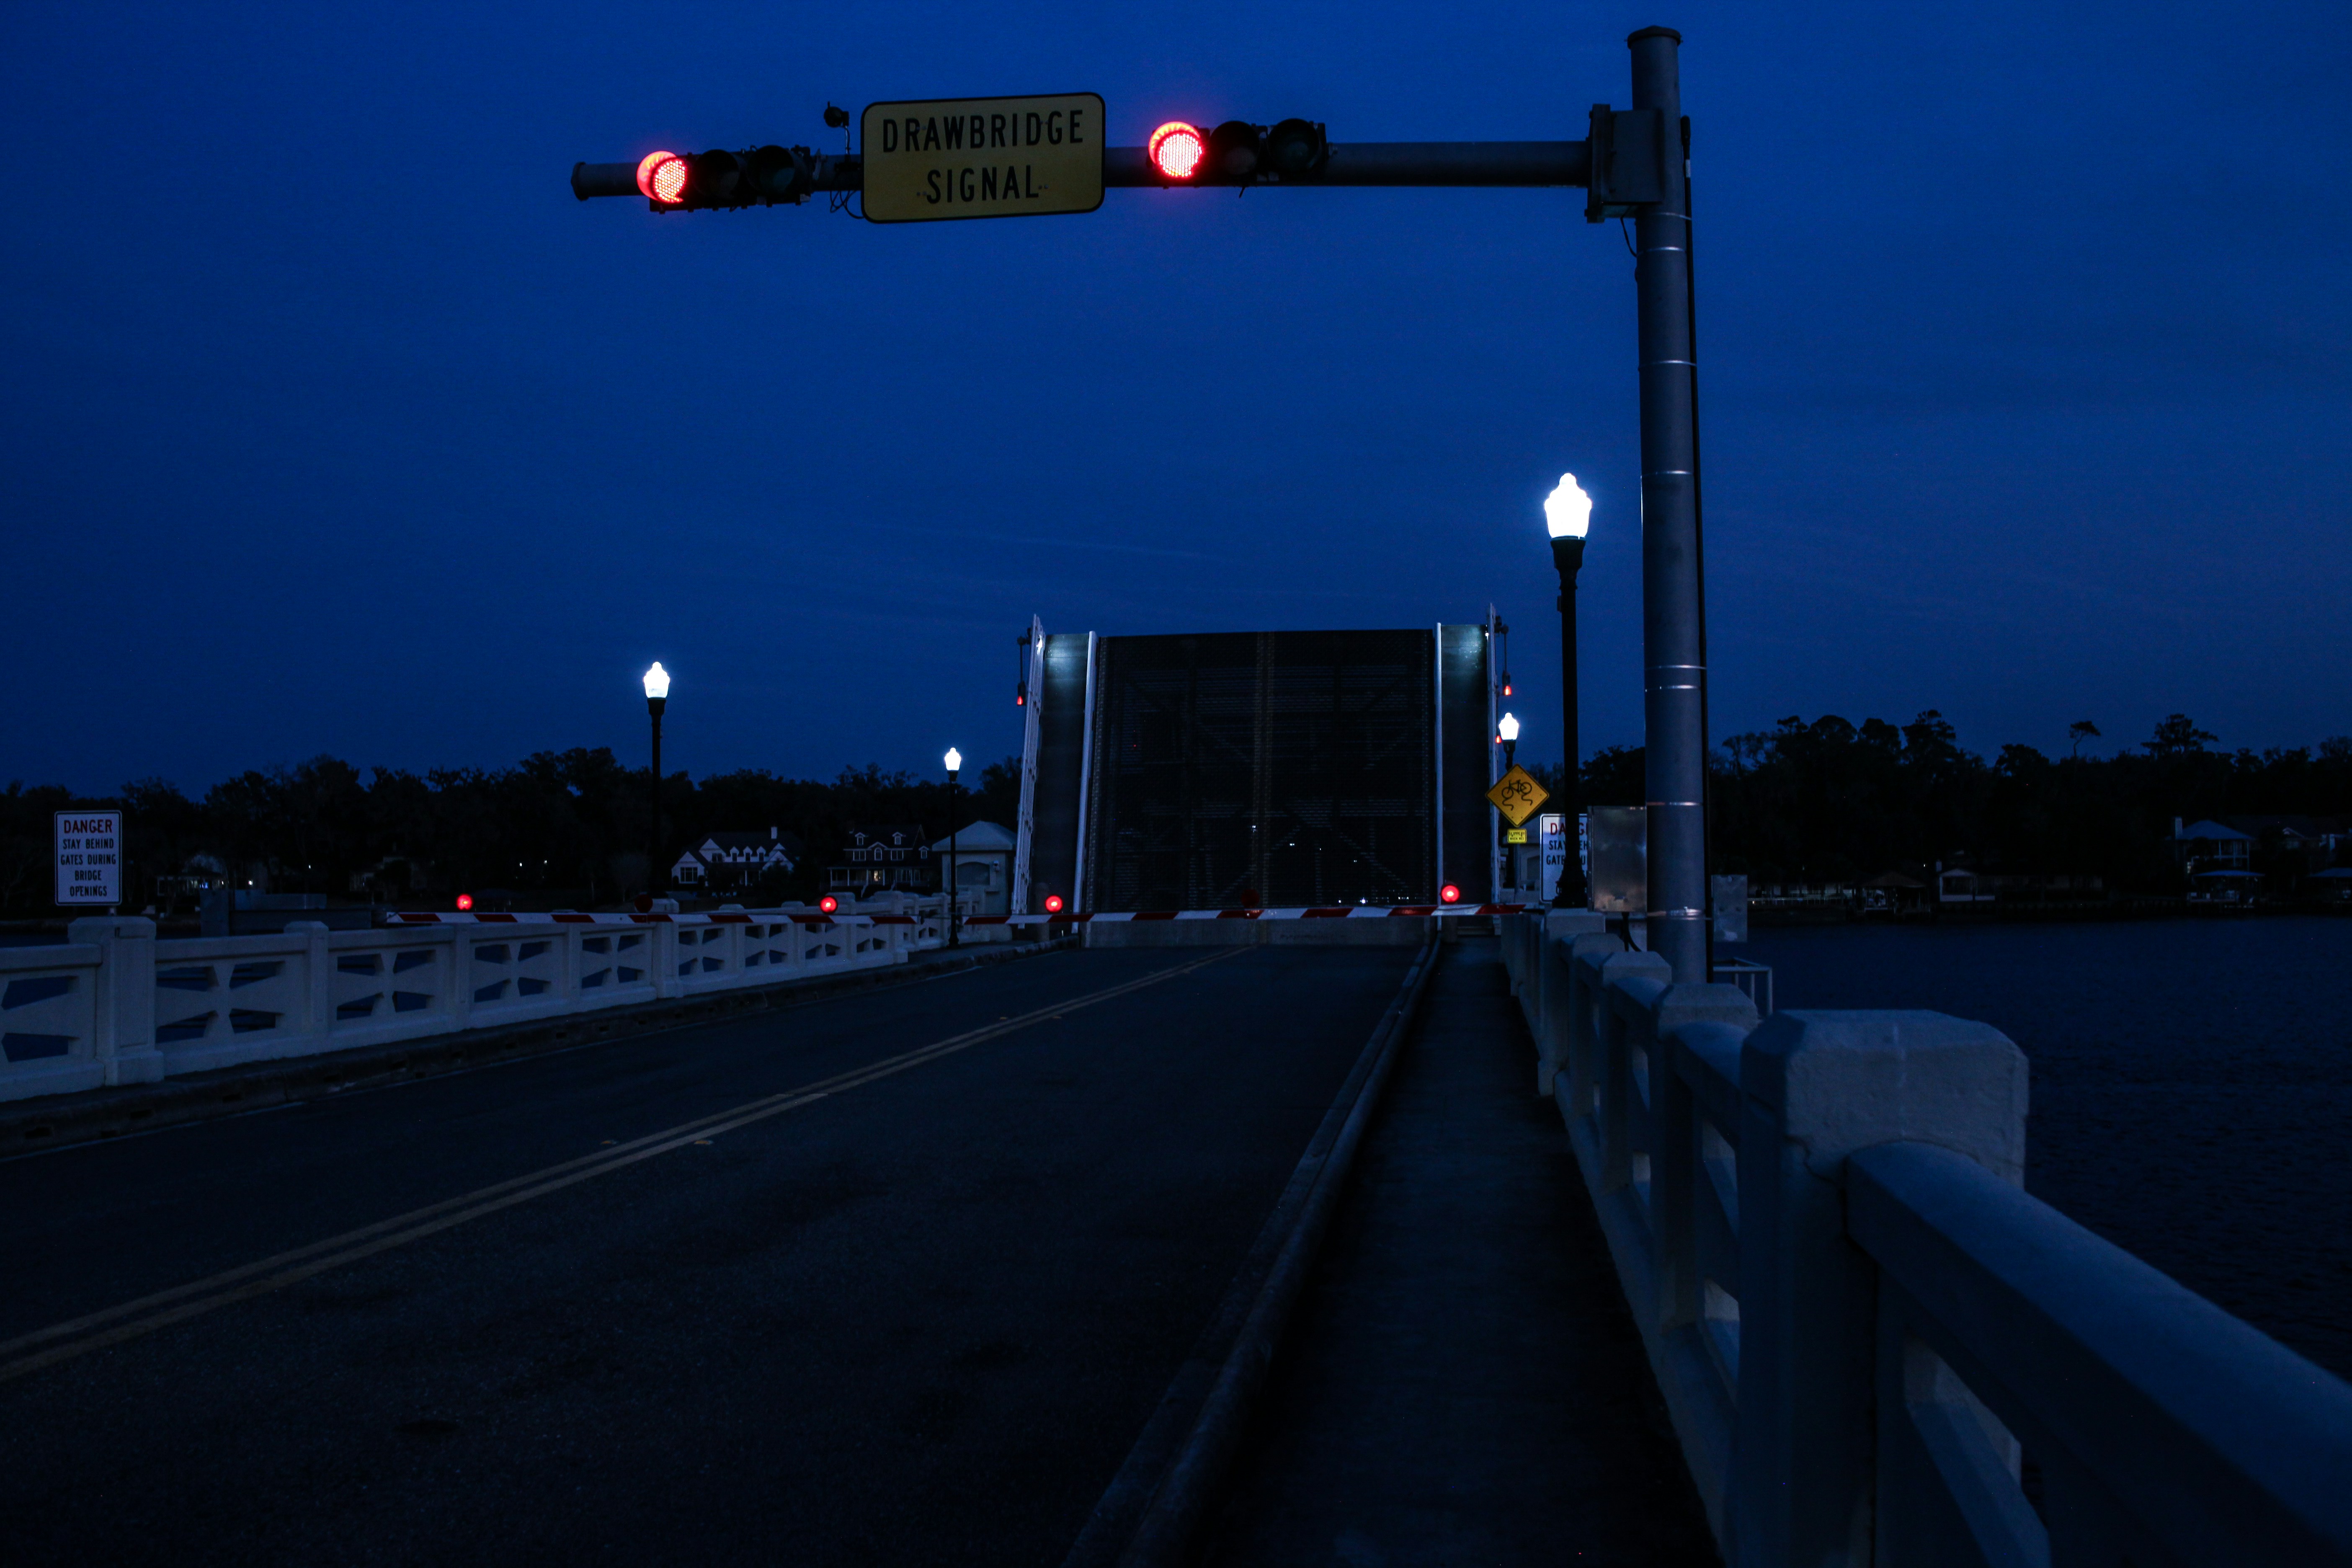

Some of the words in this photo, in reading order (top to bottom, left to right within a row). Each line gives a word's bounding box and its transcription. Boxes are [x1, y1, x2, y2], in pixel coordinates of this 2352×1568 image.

[883, 109, 1083, 153] DRAWBRIDGE
[926, 165, 1039, 204] SIGNAL
[64, 819, 112, 833] DANGER
[63, 839, 80, 849] STAY
[86, 838, 113, 849] BEHIND
[61, 854, 83, 865] GATES
[88, 854, 116, 864] DURING
[75, 870, 101, 881] BRIDGE
[70, 886, 107, 897] OPENINGS
